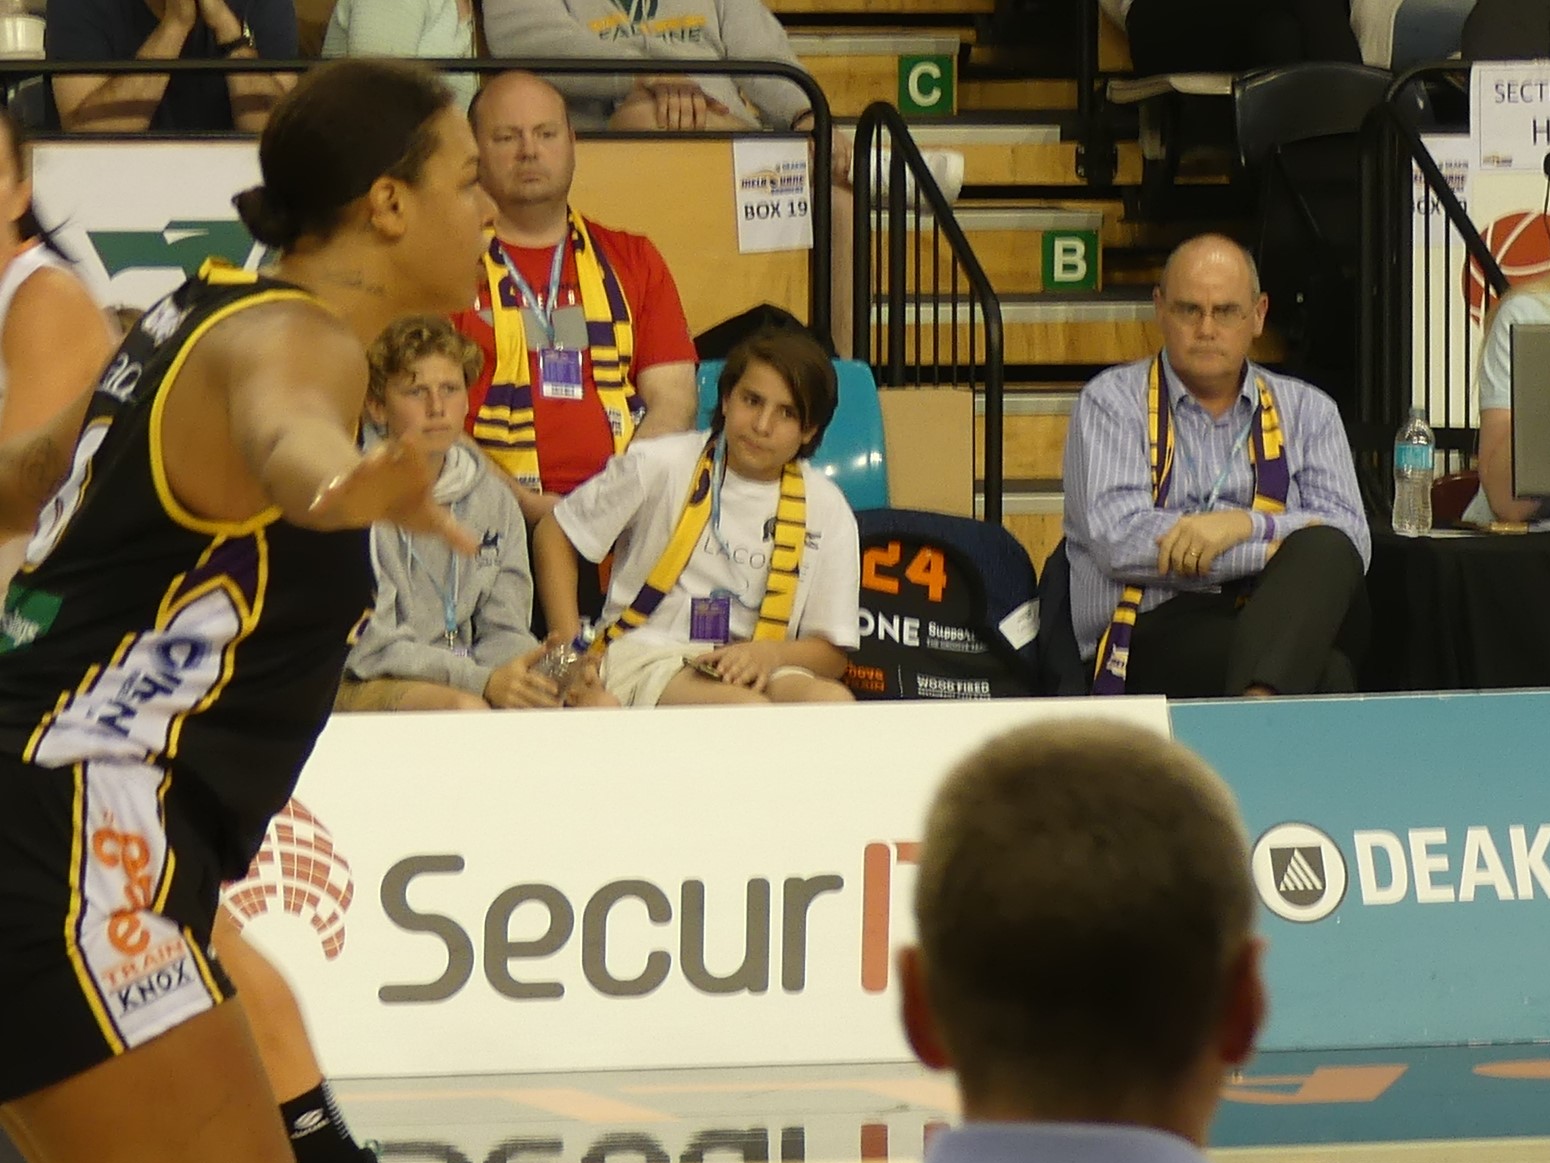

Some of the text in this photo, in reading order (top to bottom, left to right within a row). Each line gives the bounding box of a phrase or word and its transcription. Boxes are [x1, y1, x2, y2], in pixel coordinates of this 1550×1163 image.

[908, 61, 942, 107] C
[1532, 117, 1550, 146] H
[743, 199, 808, 221] BOX 19
[1053, 236, 1087, 283] B
[377, 841, 923, 1004] SecurI
[117, 957, 195, 1014] KNOX
